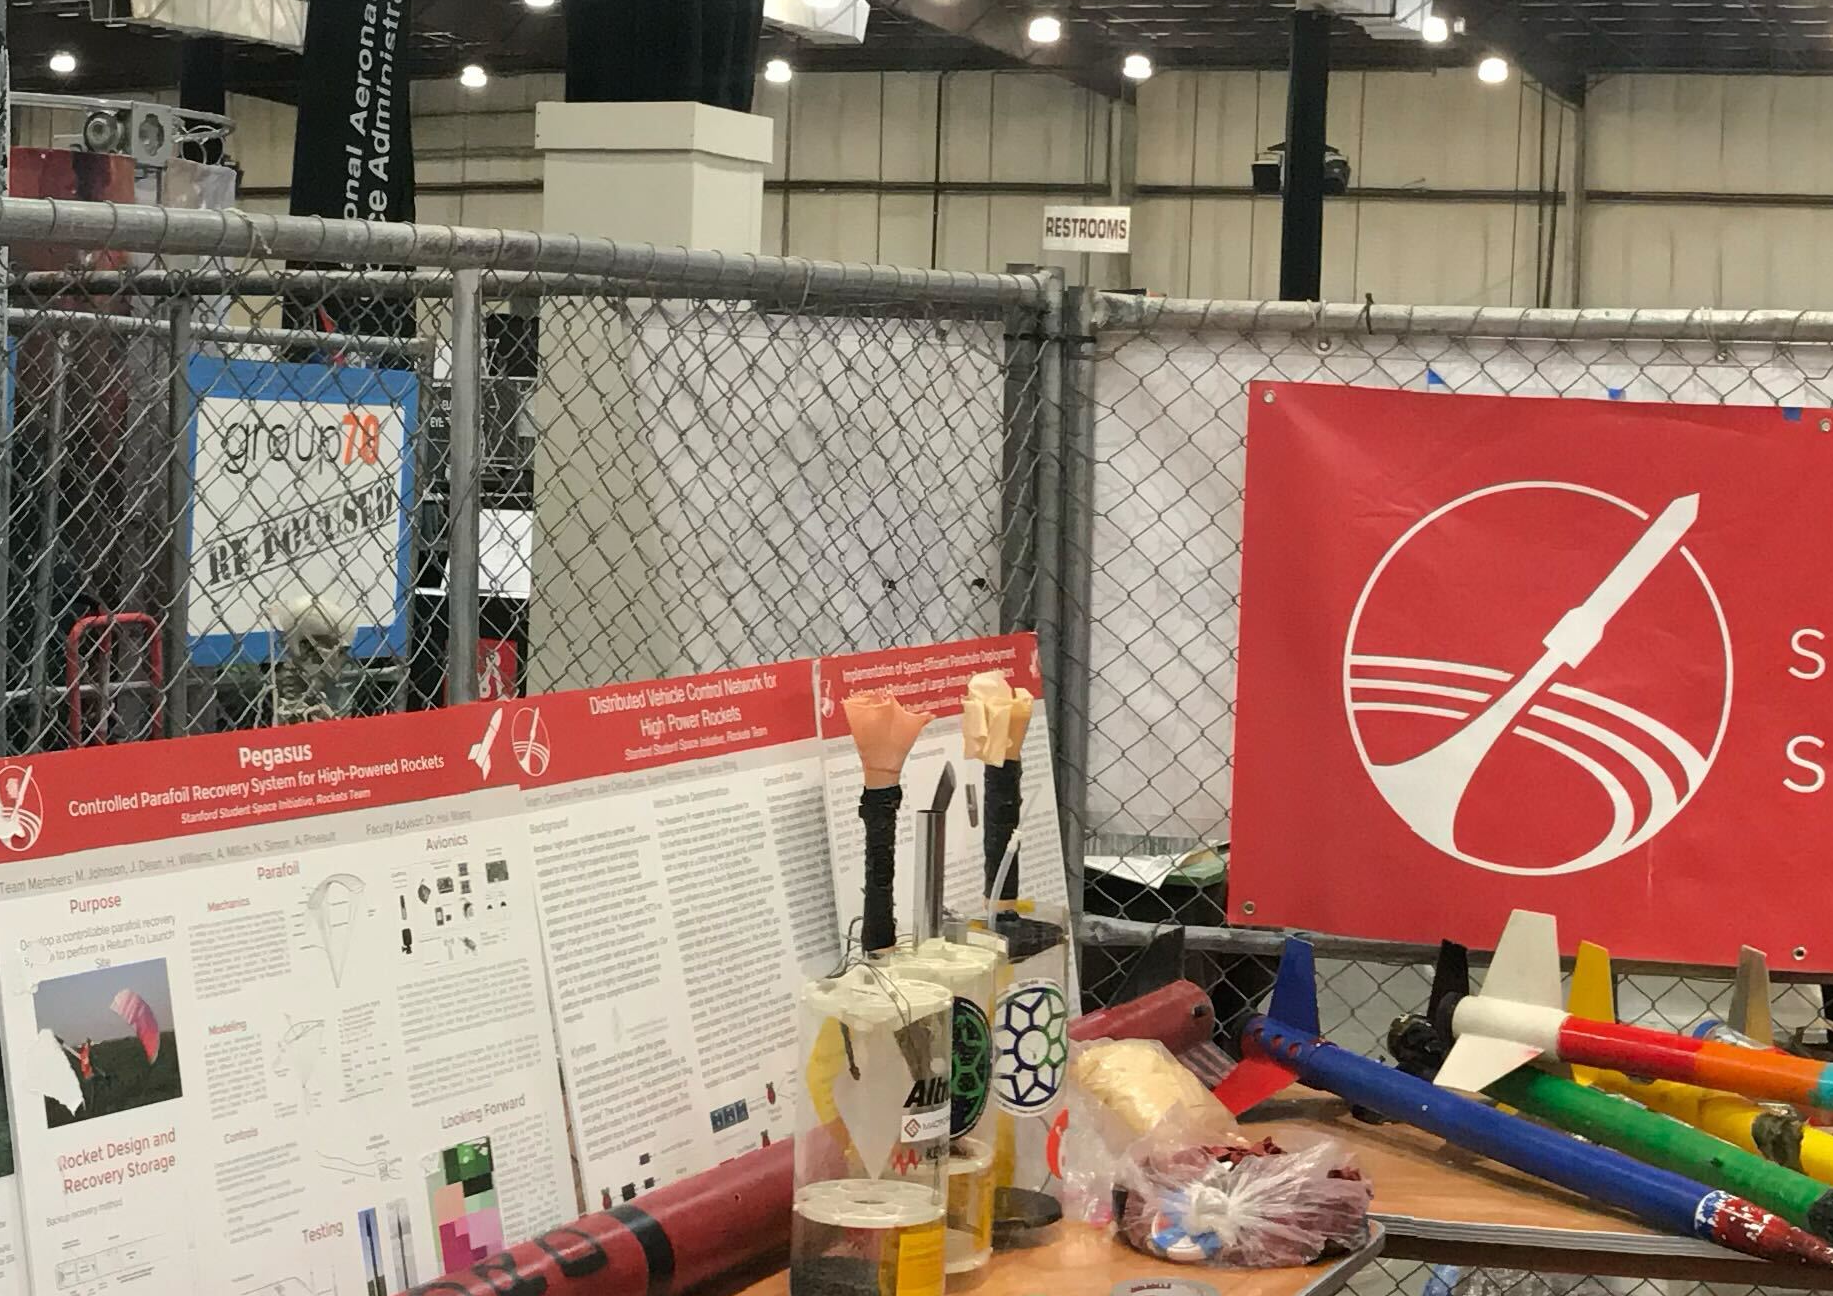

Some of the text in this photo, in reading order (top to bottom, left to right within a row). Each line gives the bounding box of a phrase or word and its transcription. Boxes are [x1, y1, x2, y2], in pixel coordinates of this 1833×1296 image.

[1046, 217, 1127, 239] RESTROOMS
[589, 691, 647, 715] Distributed
[648, 686, 686, 707] Vehicle
[724, 675, 763, 696] Network
[764, 672, 778, 689] for
[641, 706, 742, 740] High Power Rockets
[239, 744, 313, 771] Pegasus
[68, 755, 445, 817] Controlled Parafoil Recovery System for High-Powered Rockets
[425, 832, 469, 853] Avionics
[257, 861, 300, 881] Parafoil
[70, 893, 122, 914] Purpose
[441, 1093, 527, 1131] Looking Forward
[107, 1137, 150, 1159] Design
[153, 1128, 176, 1145] and
[64, 1153, 176, 1194] Recovery Storage
[302, 1220, 344, 1244] Testing
